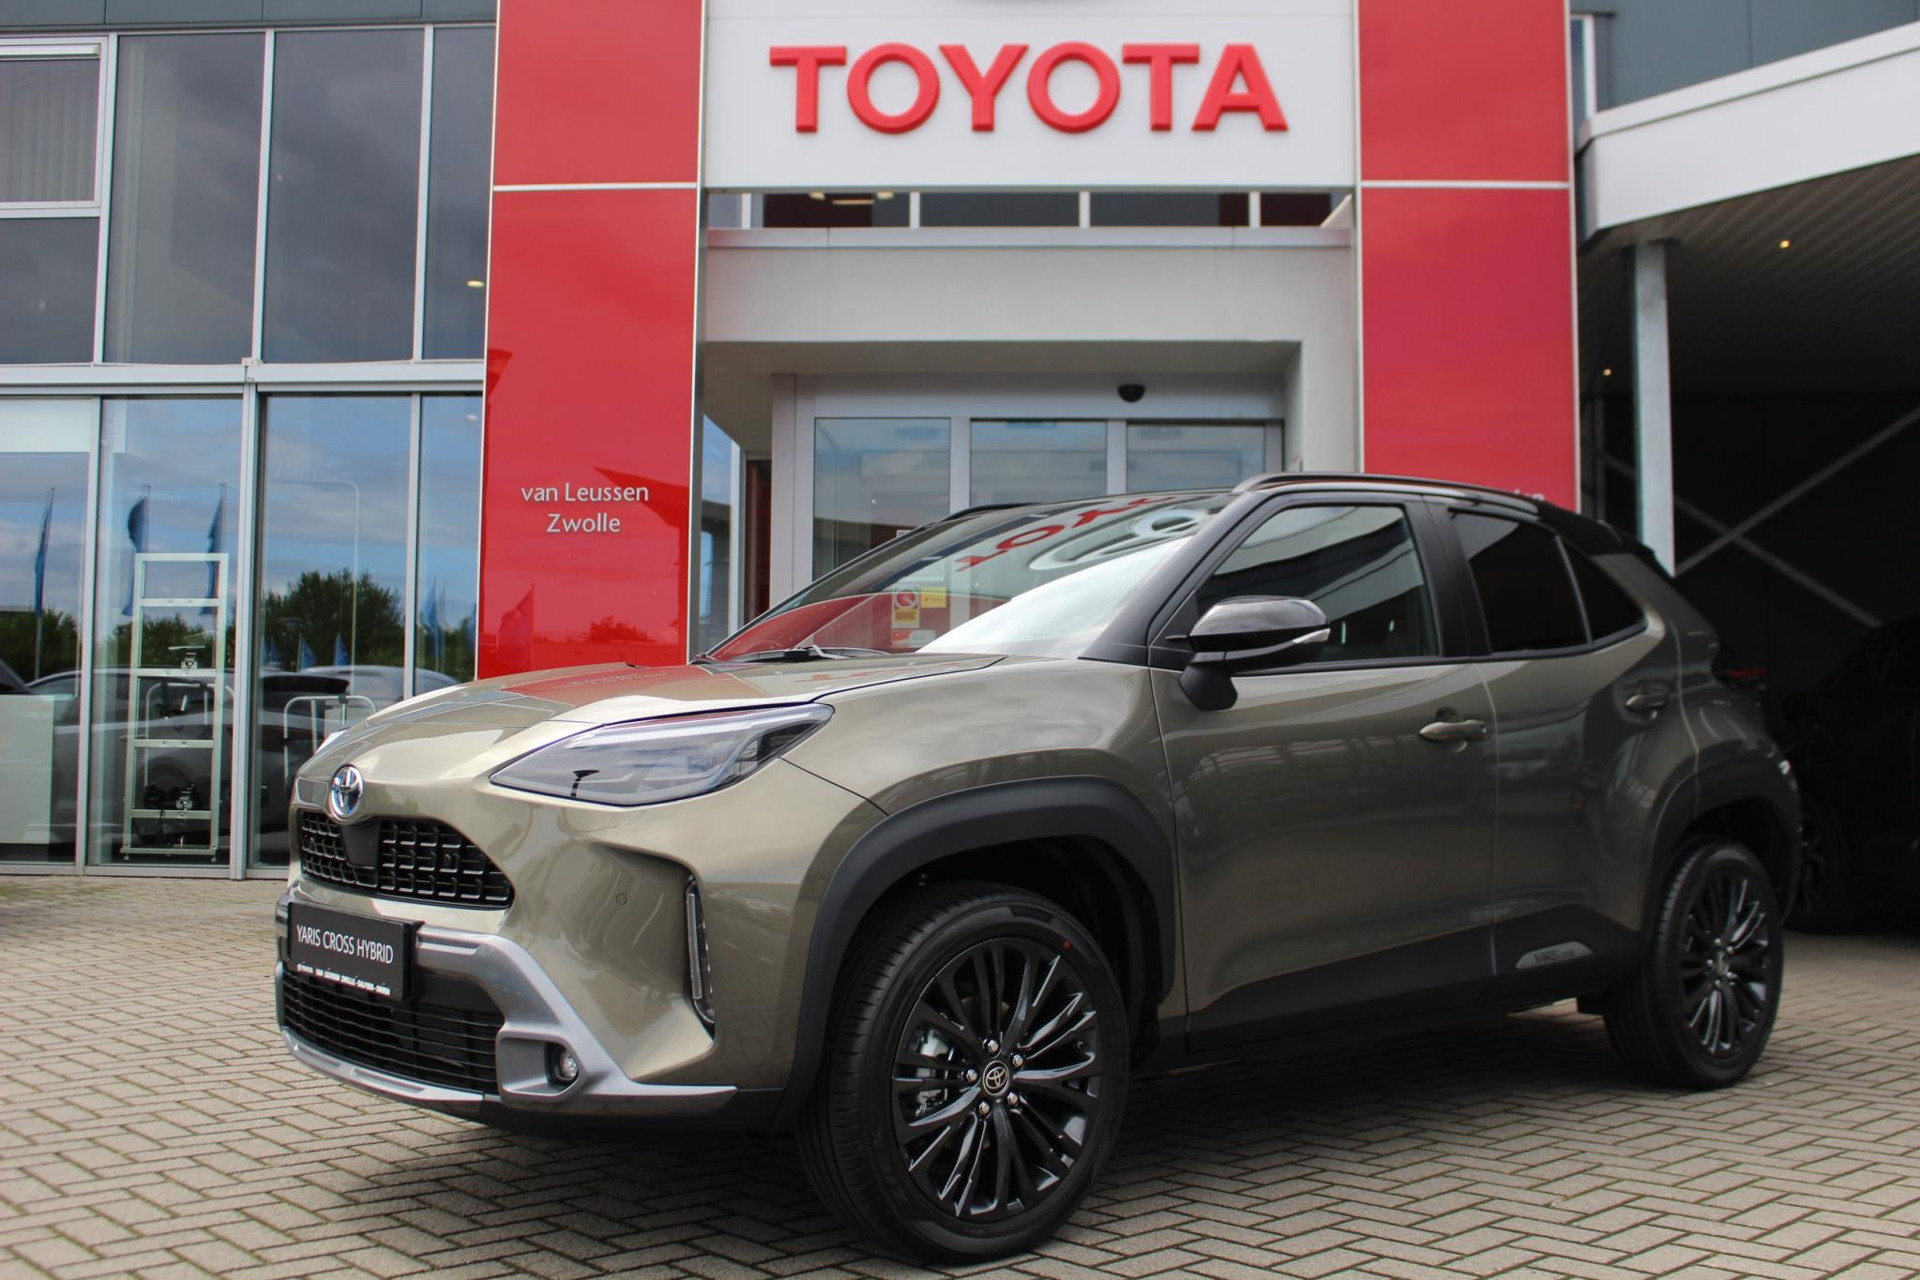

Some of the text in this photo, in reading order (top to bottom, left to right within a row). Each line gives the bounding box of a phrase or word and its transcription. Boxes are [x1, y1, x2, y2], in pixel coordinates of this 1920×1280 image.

[769, 41, 1289, 134] TOYOTA
[521, 482, 649, 501] van Leussen
[546, 512, 621, 533] Zwolle
[296, 924, 394, 964] YARIS CROSS HYBRID
